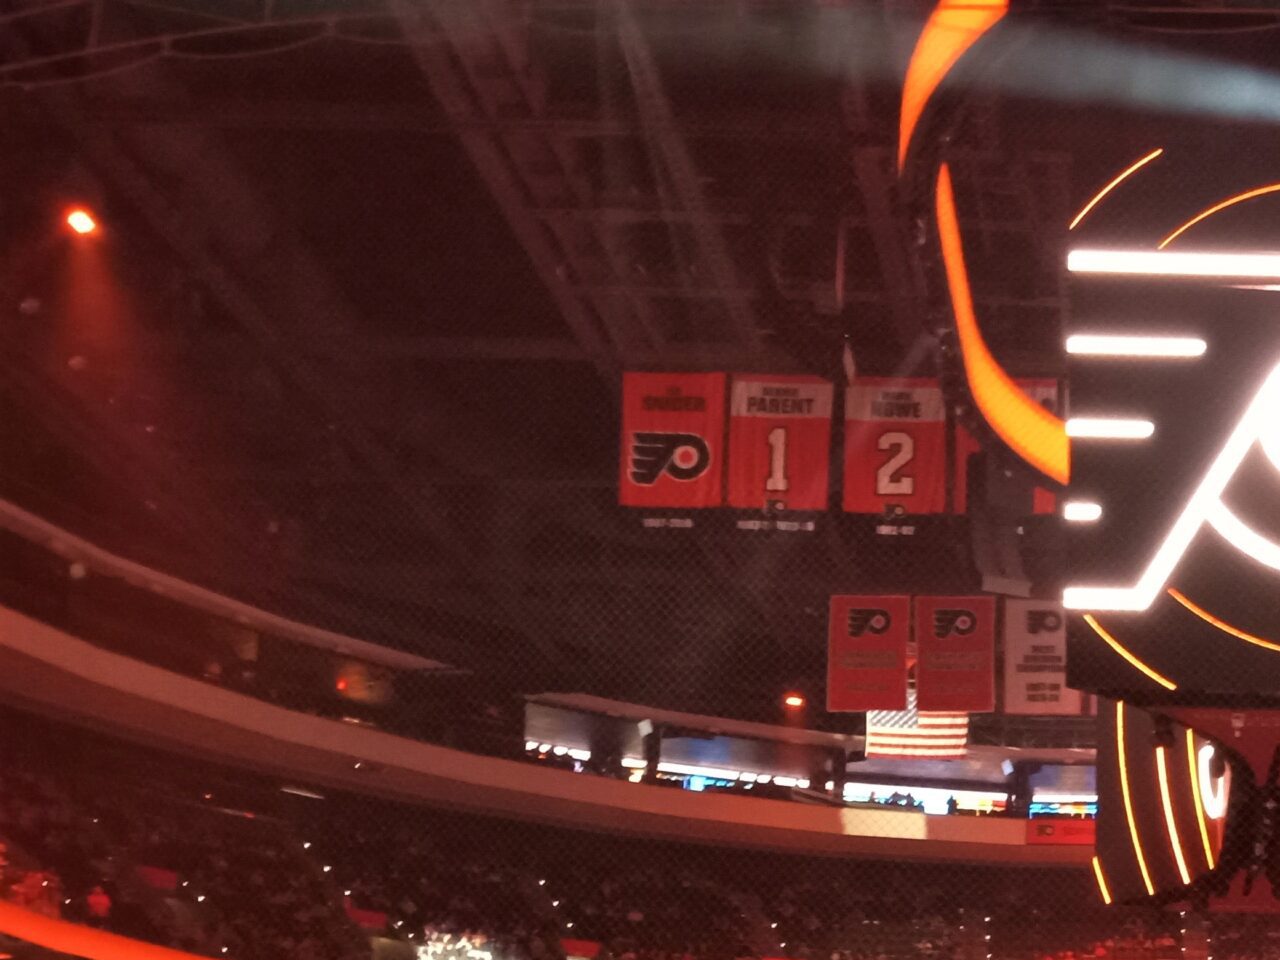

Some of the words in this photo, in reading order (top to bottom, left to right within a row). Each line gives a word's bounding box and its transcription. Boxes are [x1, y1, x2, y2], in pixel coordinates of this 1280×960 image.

[747, 397, 814, 414] PARENT
[766, 428, 788, 490] 1
[877, 432, 914, 494] 2
